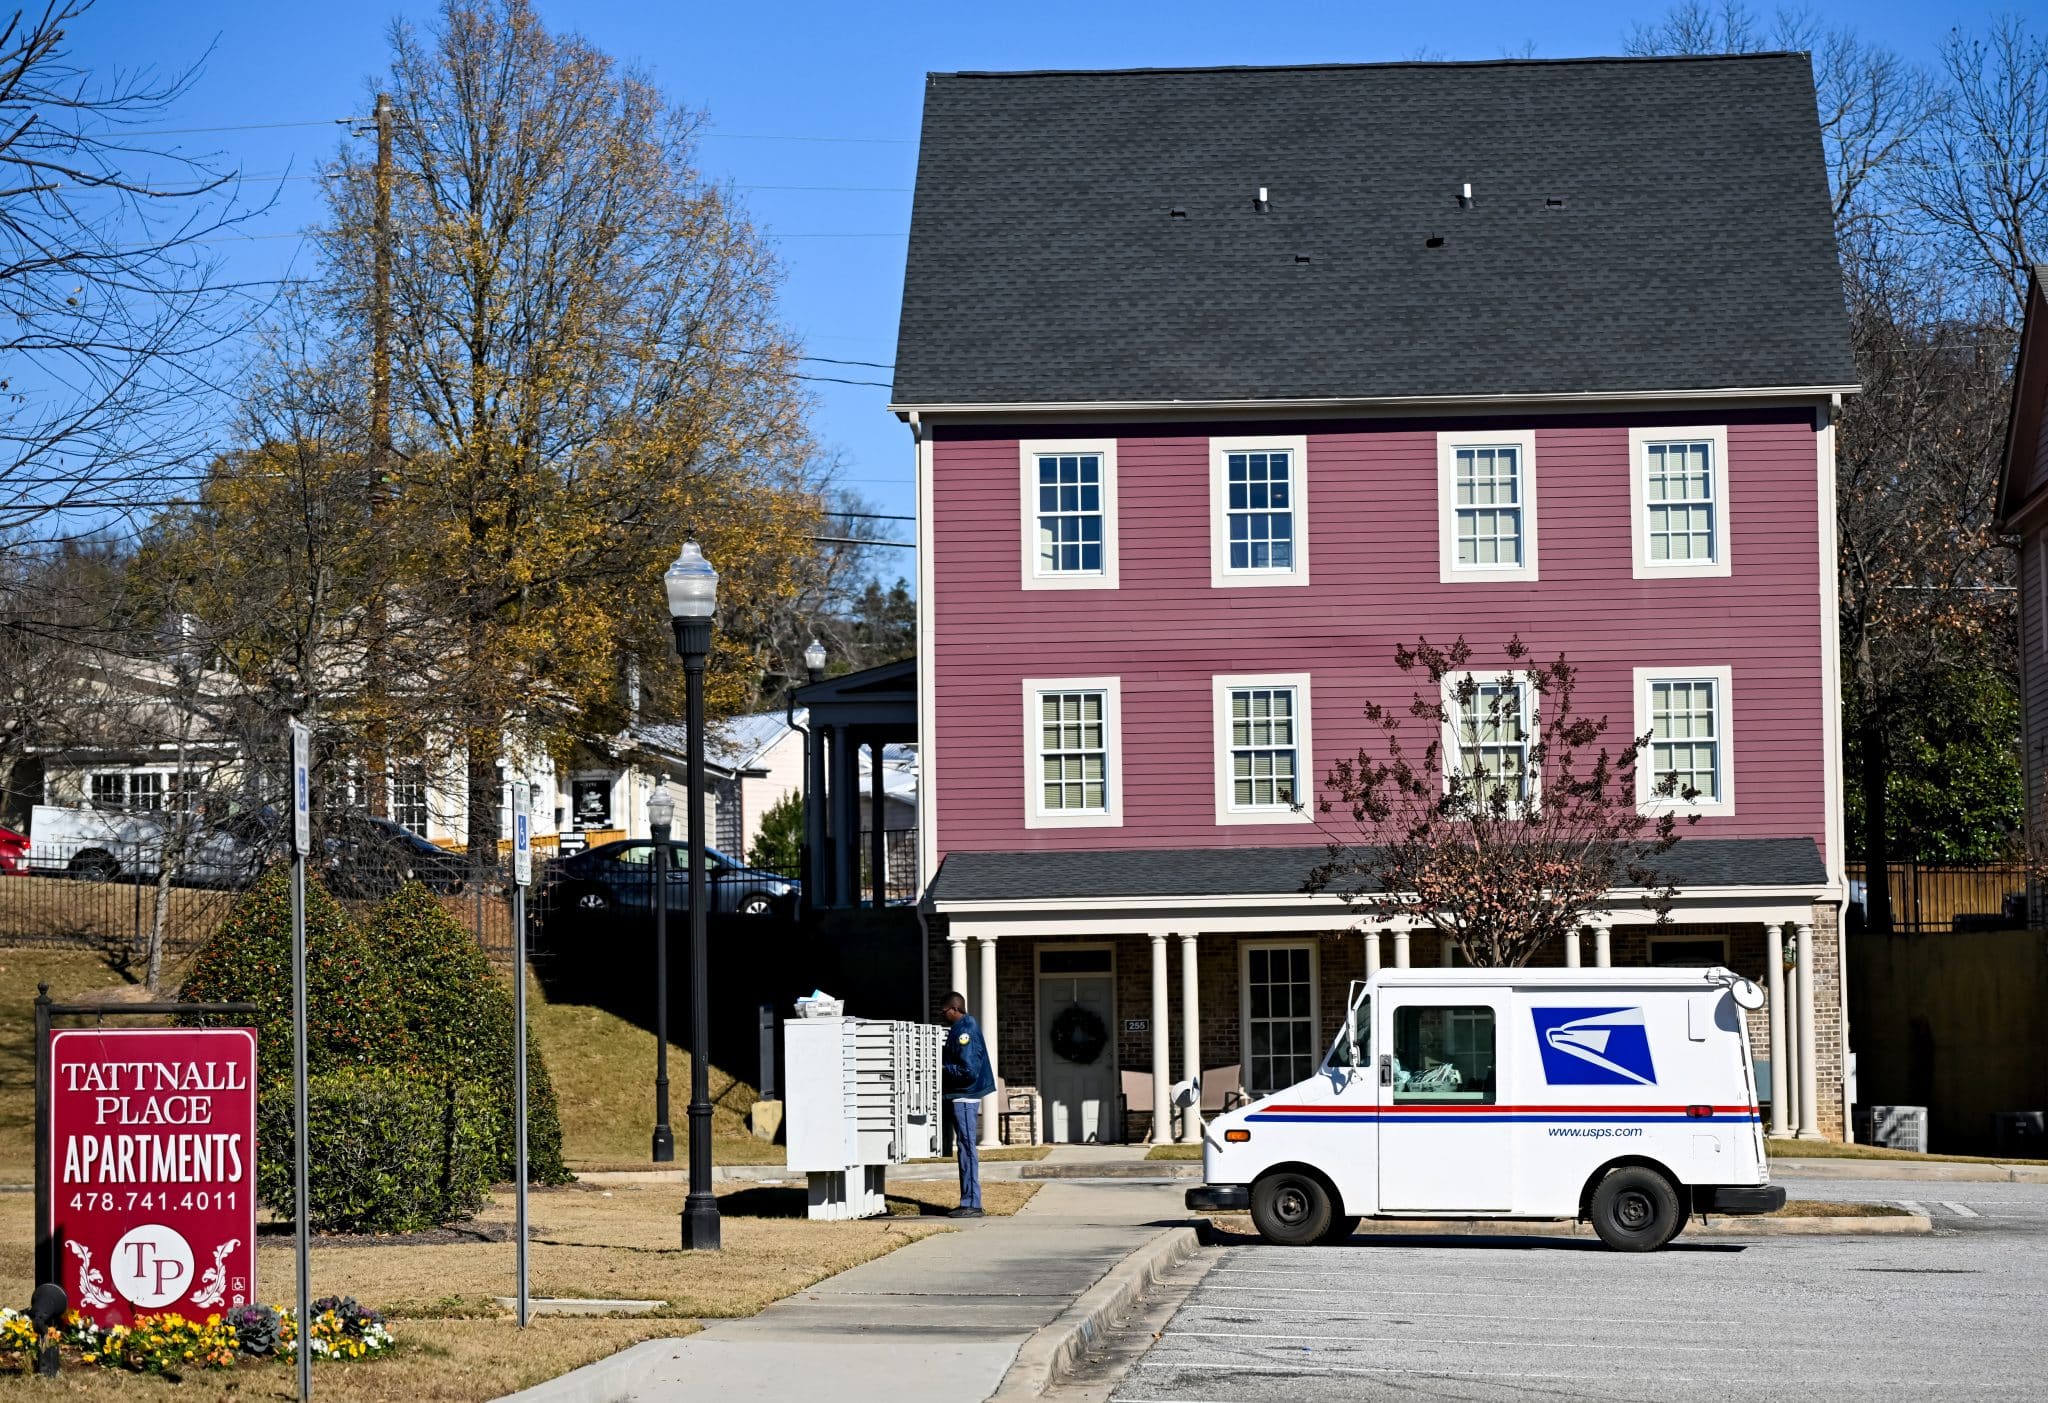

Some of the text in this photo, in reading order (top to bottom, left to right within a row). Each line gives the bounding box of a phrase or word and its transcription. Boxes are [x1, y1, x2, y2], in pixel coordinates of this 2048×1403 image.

[62, 1062, 246, 1091] TATTNALL
[95, 1095, 212, 1125] PLACE
[1548, 1127, 1643, 1139] www.usps.com
[63, 1133, 243, 1184] APARTMENTS
[70, 1192, 237, 1211] 478.741.4011
